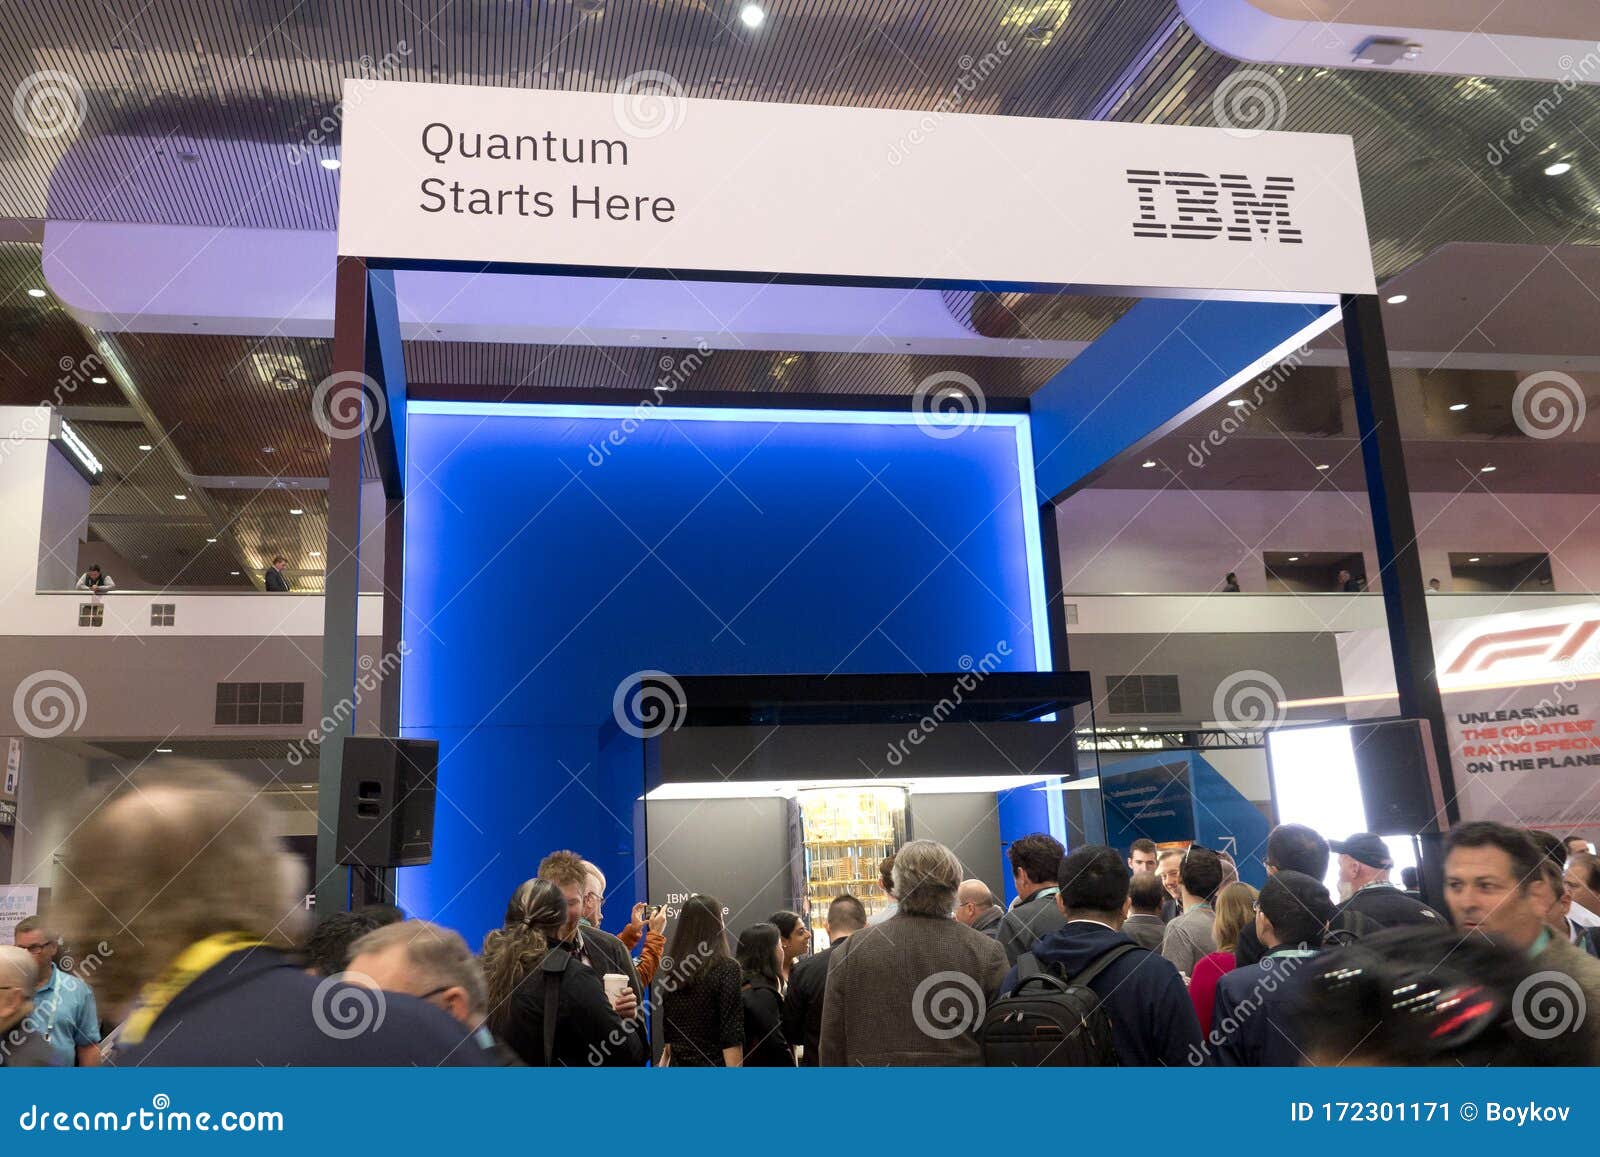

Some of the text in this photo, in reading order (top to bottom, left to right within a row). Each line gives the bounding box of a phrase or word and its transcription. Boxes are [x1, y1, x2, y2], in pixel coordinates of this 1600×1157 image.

[421, 123, 628, 165] Quantum
[420, 178, 676, 223] Starts Here
[1126, 169, 1303, 243] IBM
[1458, 704, 1579, 724] UNLEASHING
[1461, 728, 1498, 740] THE
[1466, 761, 1493, 773] ON
[1500, 757, 1534, 771] THE
[667, 893, 688, 904] IBM
